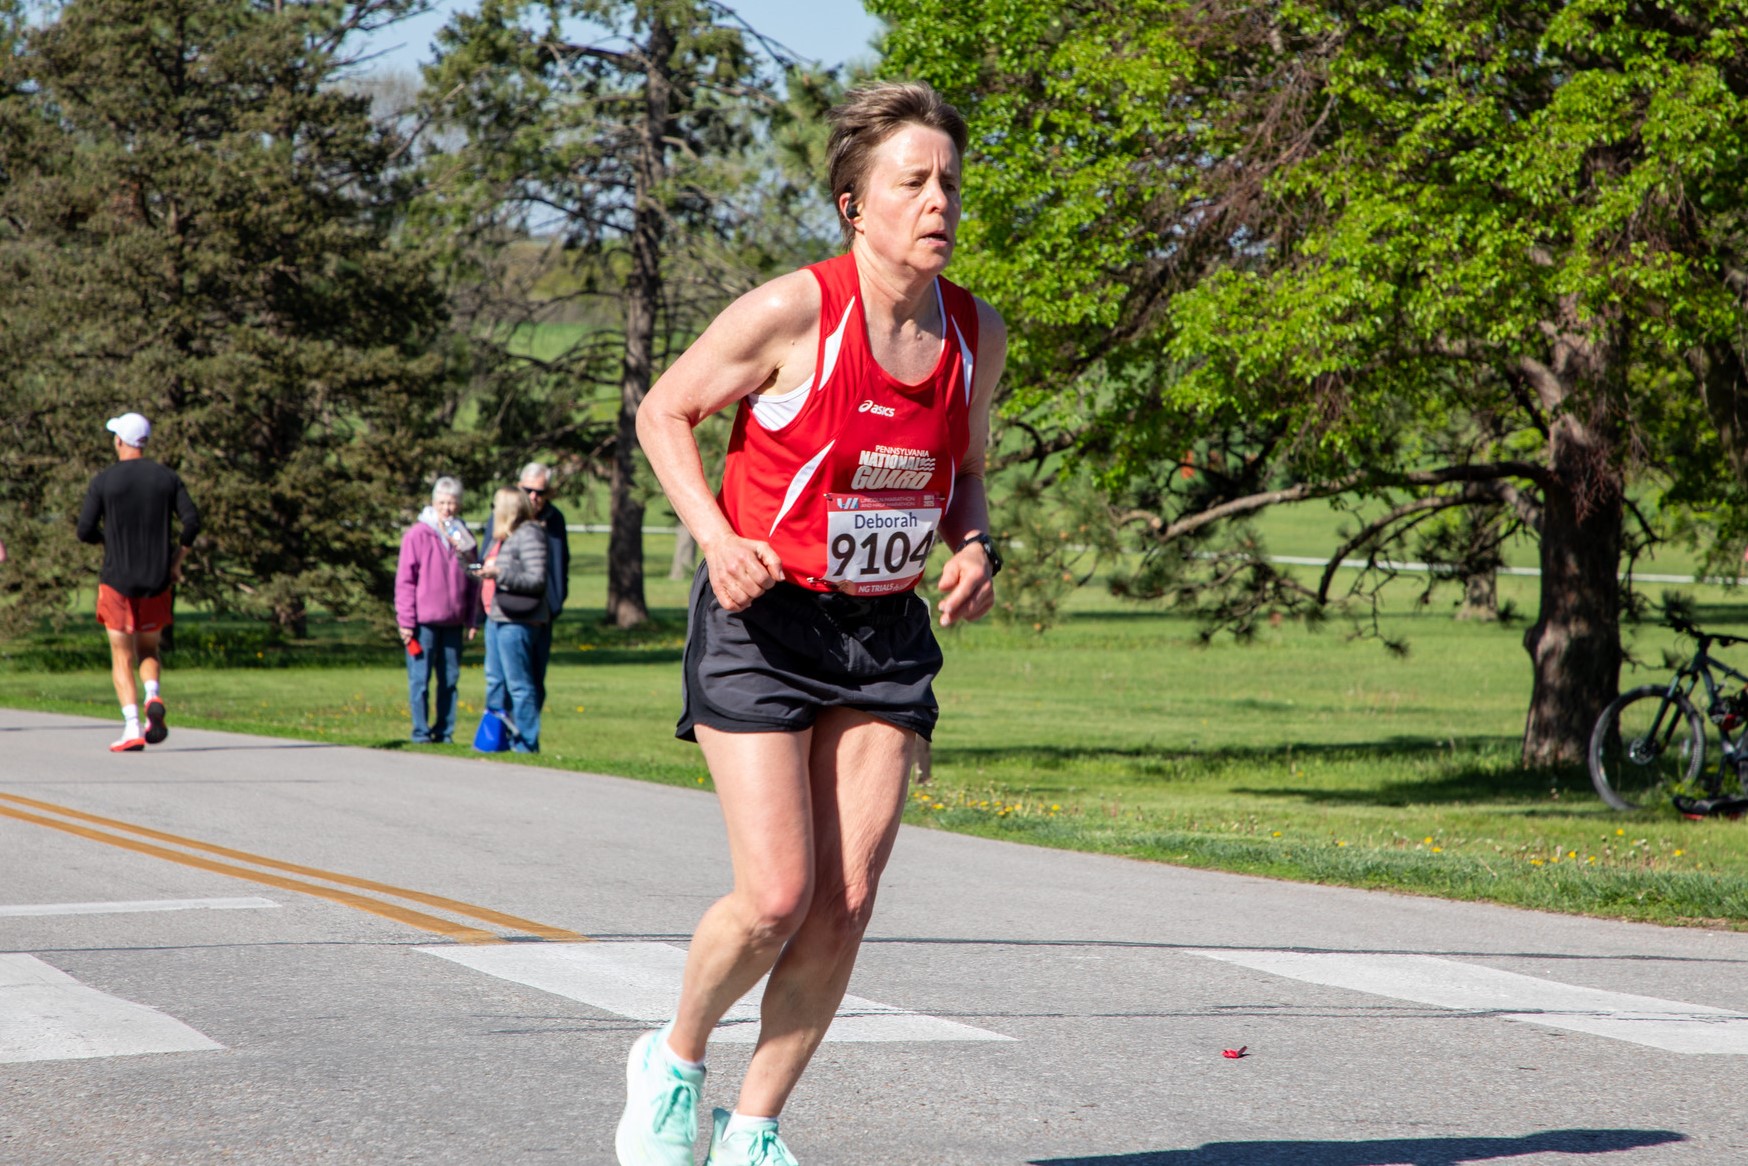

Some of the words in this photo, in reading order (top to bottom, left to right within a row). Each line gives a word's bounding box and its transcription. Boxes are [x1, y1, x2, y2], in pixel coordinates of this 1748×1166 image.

[859, 450, 922, 471] NATIONAL
[875, 445, 929, 457] PENNSYLVANIA
[851, 466, 933, 490] GUARD
[855, 512, 917, 529] Deborah
[832, 532, 934, 576] 9104
